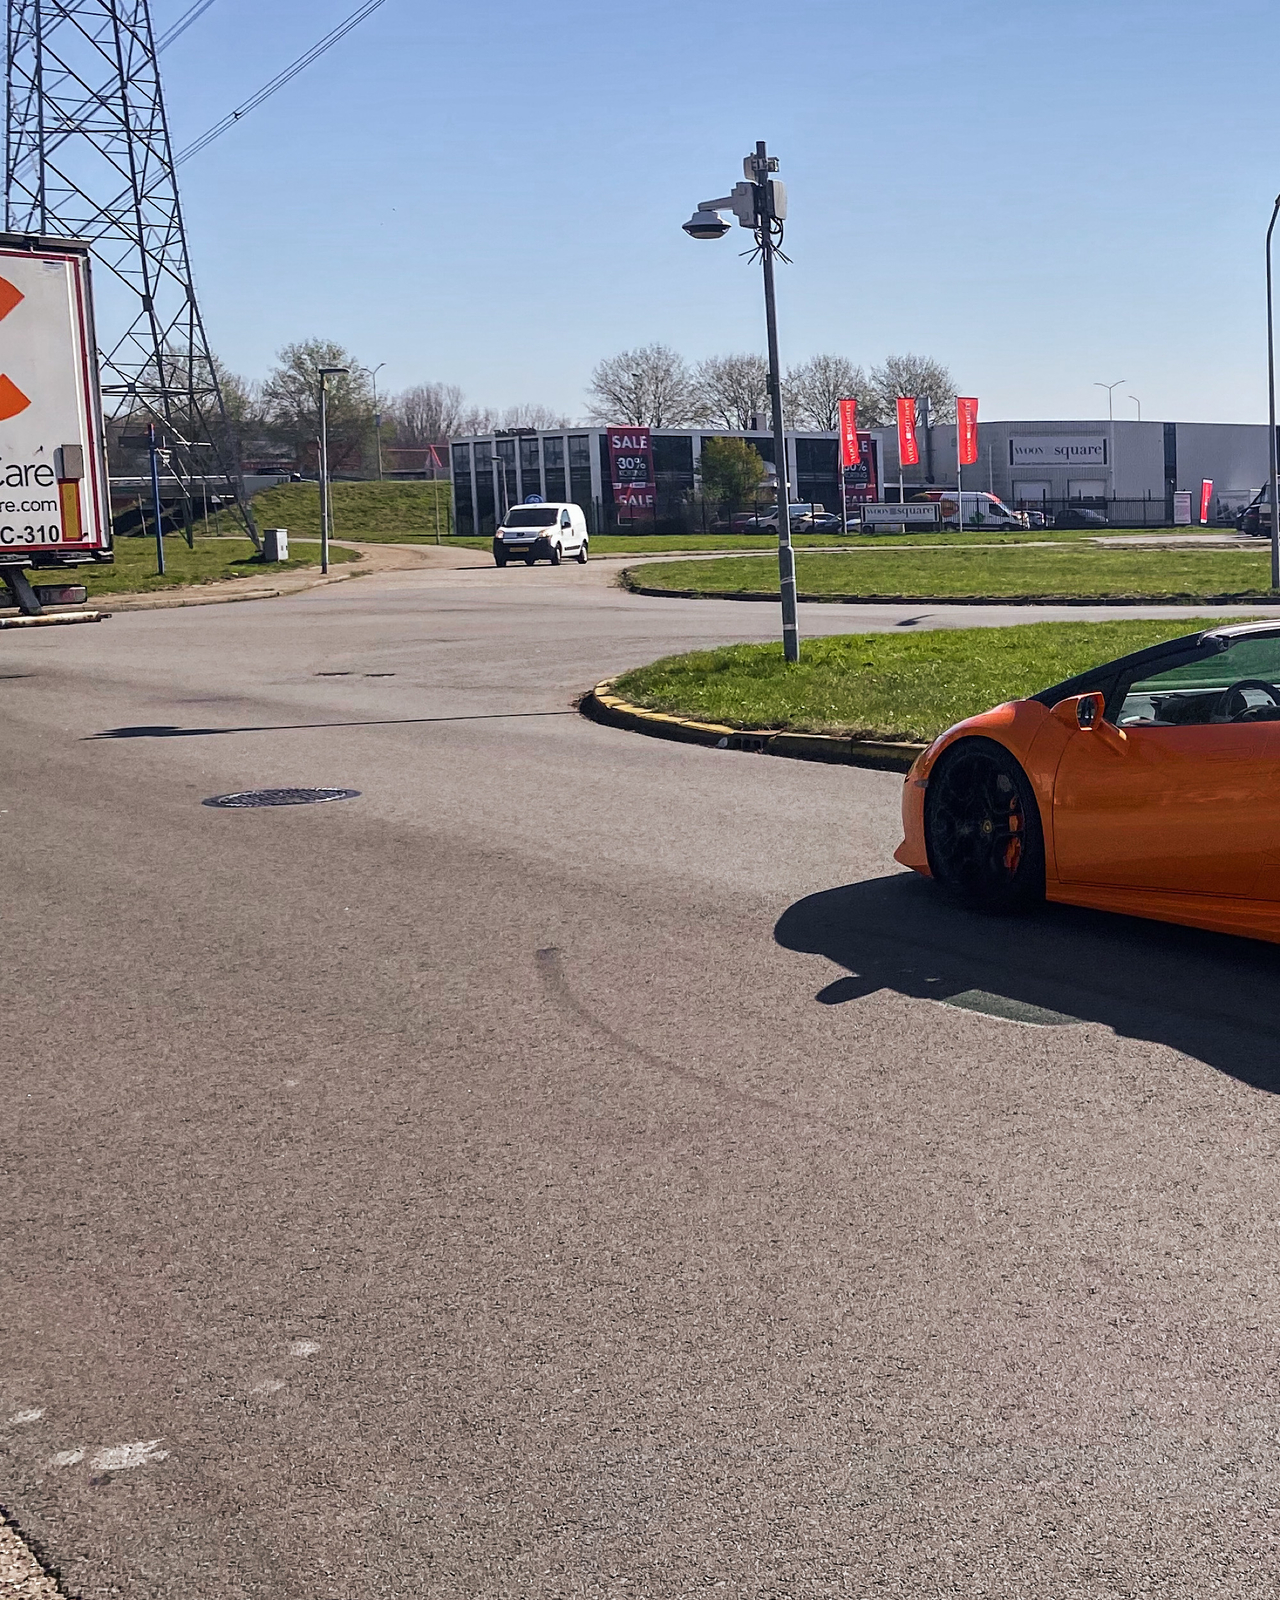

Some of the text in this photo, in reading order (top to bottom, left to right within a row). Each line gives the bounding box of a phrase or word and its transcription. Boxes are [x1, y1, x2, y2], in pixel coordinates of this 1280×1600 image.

[612, 435, 648, 449] SALE
[1054, 445, 1102, 460] square
[0, 457, 54, 487] are
[619, 495, 653, 508] SALE
[897, 507, 933, 518] square
[0, 525, 60, 544] C-310
